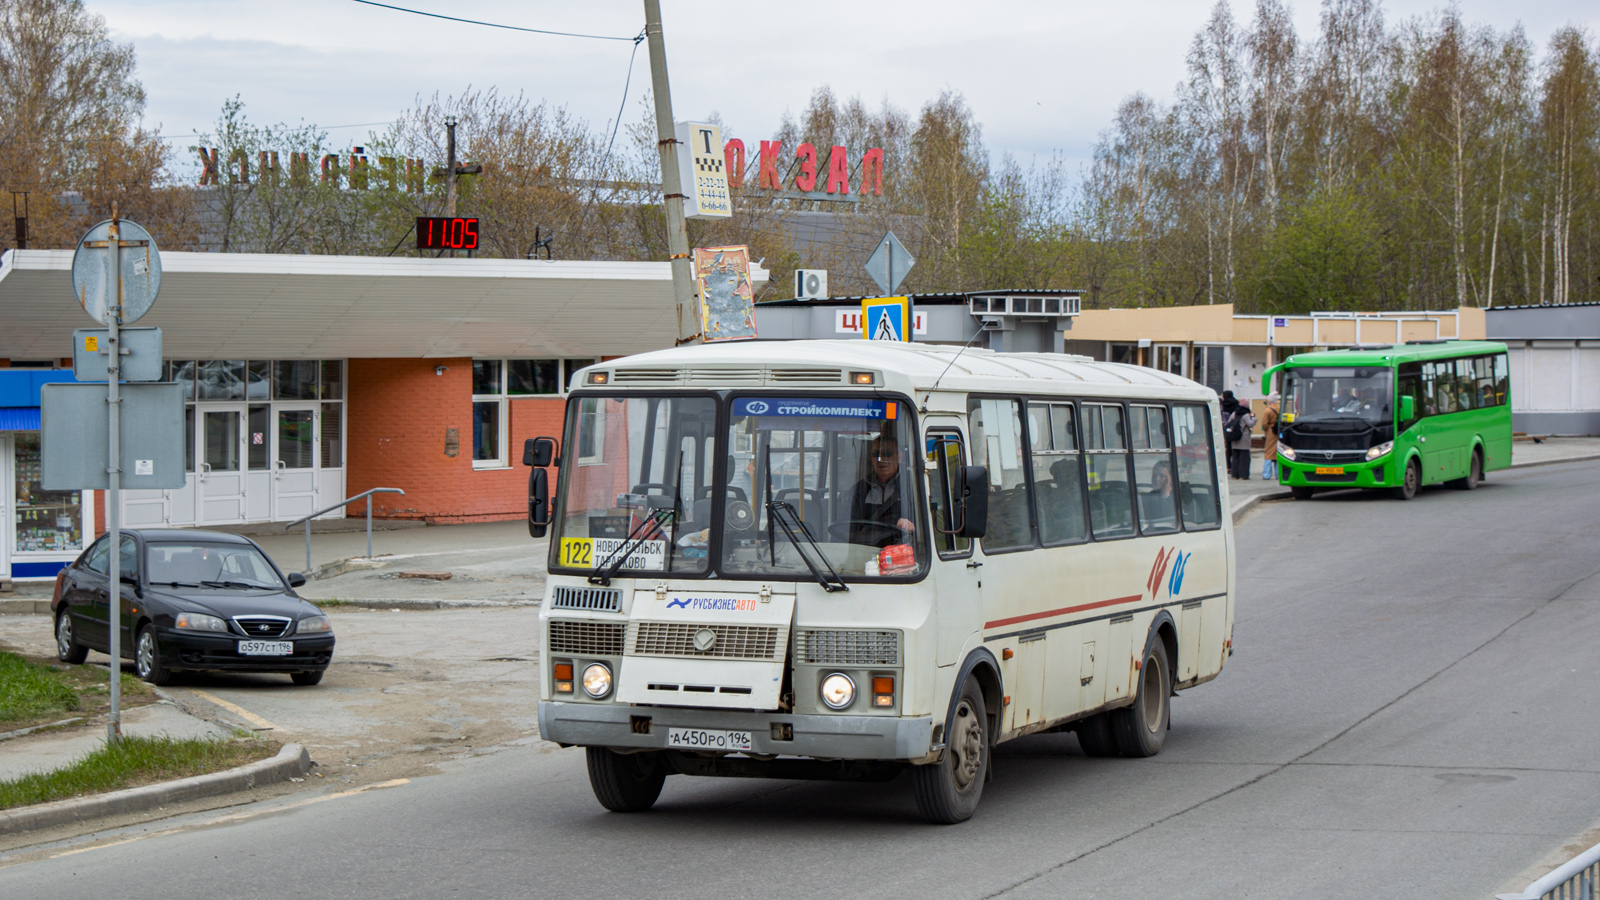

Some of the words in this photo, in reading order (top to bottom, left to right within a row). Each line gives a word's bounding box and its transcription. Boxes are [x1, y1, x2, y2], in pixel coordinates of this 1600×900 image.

[724, 138, 884, 196] ОКЗАЛ
[699, 177, 725, 189] 2-22-22
[700, 189, 726, 200] 4-44-44
[701, 200, 727, 212] 6-66-66
[427, 218, 478, 249] 11.05
[778, 405, 882, 417] СТРОЙКОМПЛЕКТ
[565, 541, 591, 564] 122
[693, 598, 757, 611] РУСБИЗНЕСАВТО
[673, 730, 725, 747] А450РО
